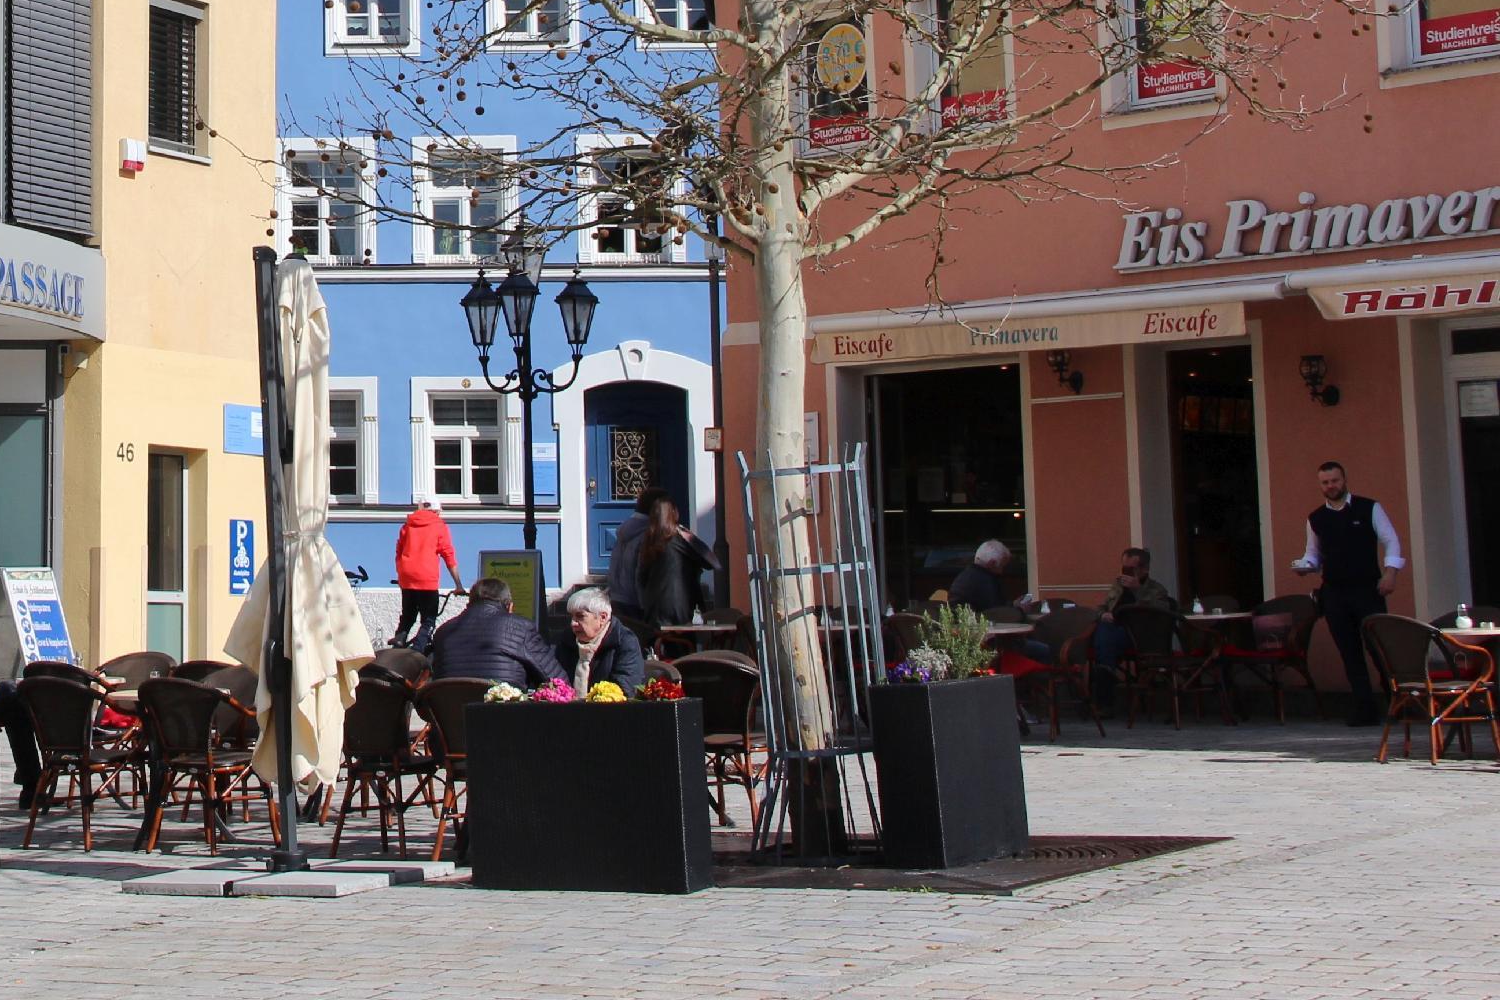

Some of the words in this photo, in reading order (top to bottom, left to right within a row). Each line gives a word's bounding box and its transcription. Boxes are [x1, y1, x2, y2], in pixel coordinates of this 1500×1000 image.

[1426, 21, 1500, 43] Studienkreis
[1441, 36, 1487, 49] NACHHILFE
[1143, 66, 1206, 88] Studienkreis
[1155, 81, 1194, 94] NACHHILFE
[1112, 207, 1207, 270] Eis
[833, 331, 894, 358] Eiscafe
[969, 325, 1060, 347] Primavera
[1141, 308, 1219, 338] Eiscafe
[116, 442, 135, 463] 46
[236, 520, 248, 547] P
